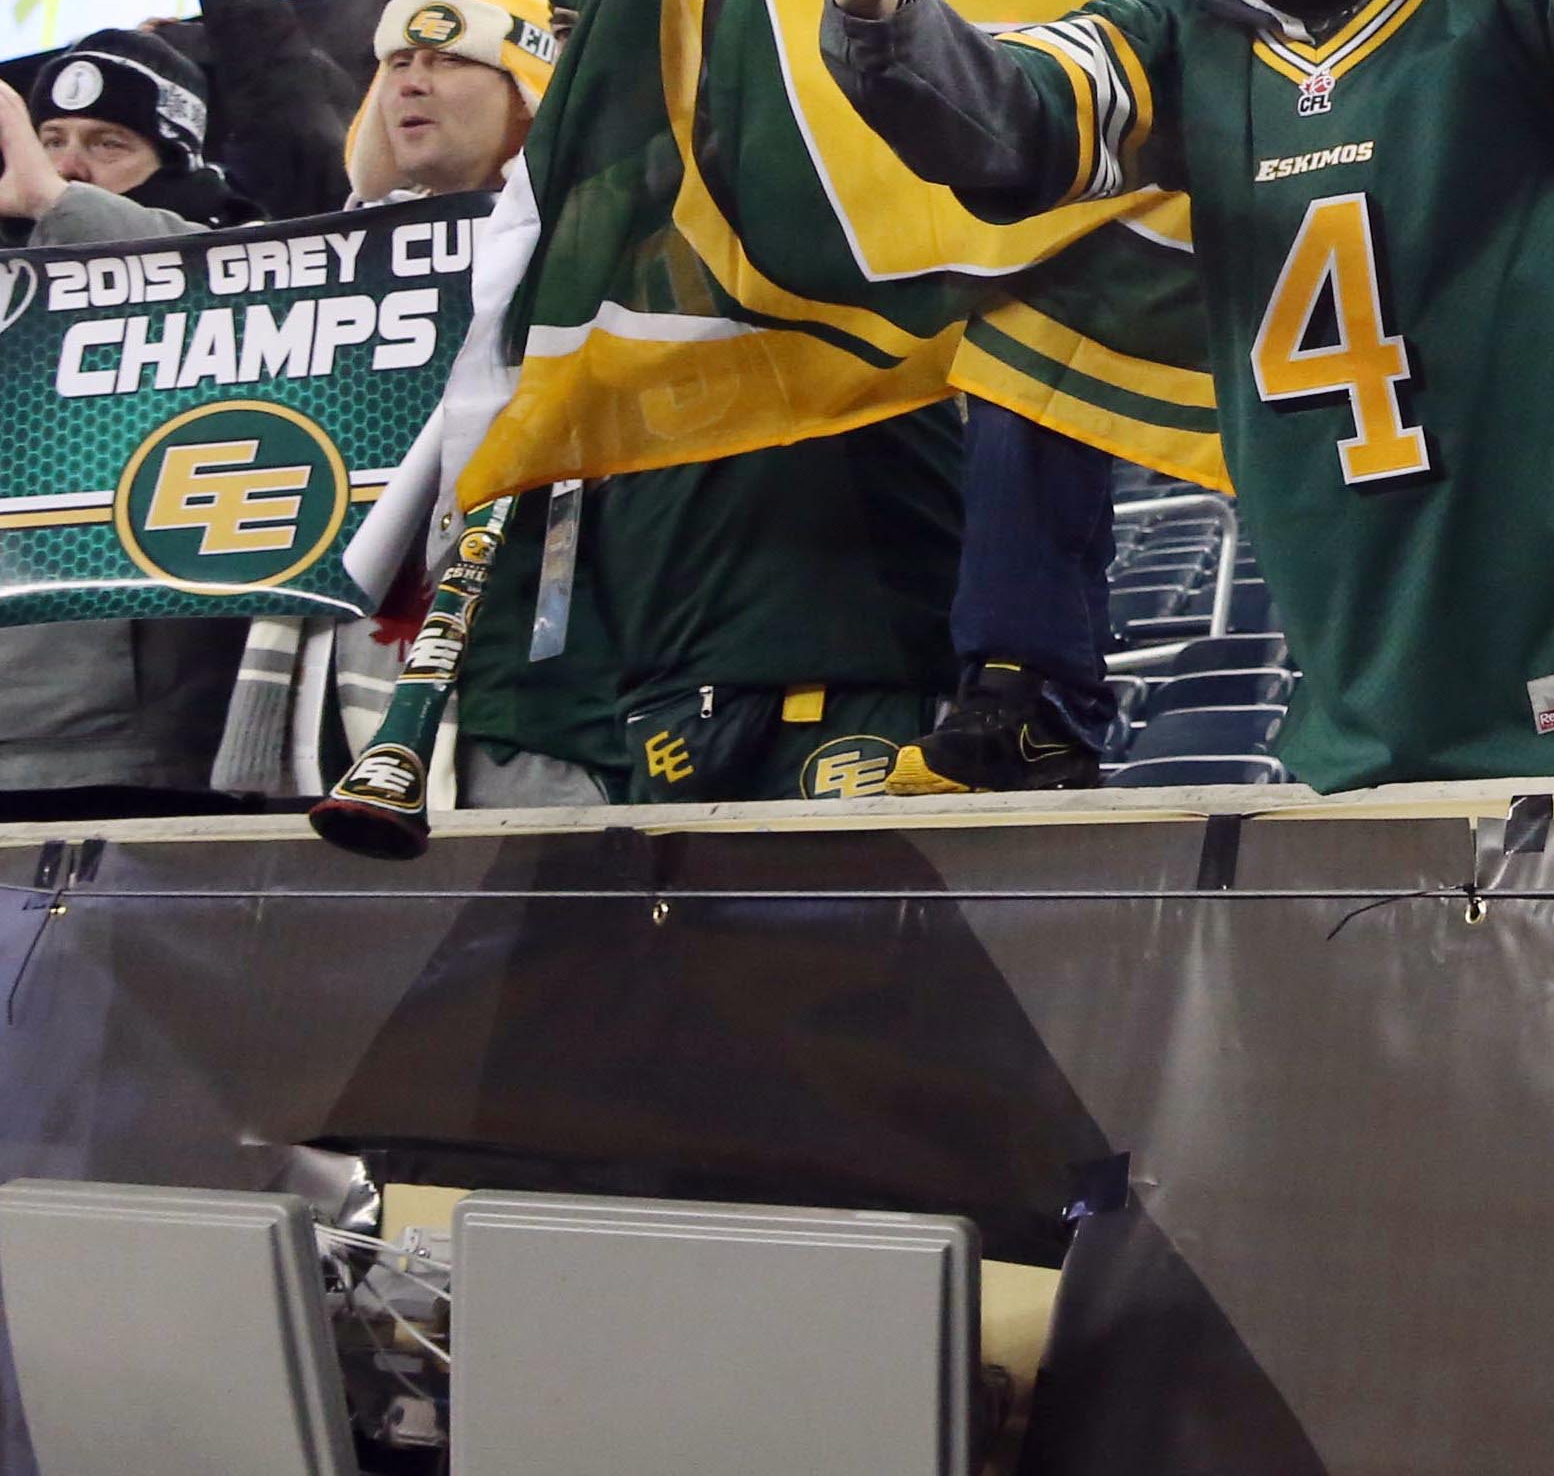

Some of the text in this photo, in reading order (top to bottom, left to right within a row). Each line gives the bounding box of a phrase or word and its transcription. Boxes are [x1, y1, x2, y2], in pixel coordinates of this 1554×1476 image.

[1299, 94, 1330, 113] CFL
[1253, 140, 1375, 183] ESKIMOS
[45, 219, 474, 312] 2015 GREY CU
[55, 287, 440, 398] CHAMPS
[1249, 191, 1431, 486] 4
[144, 438, 313, 556] EE
